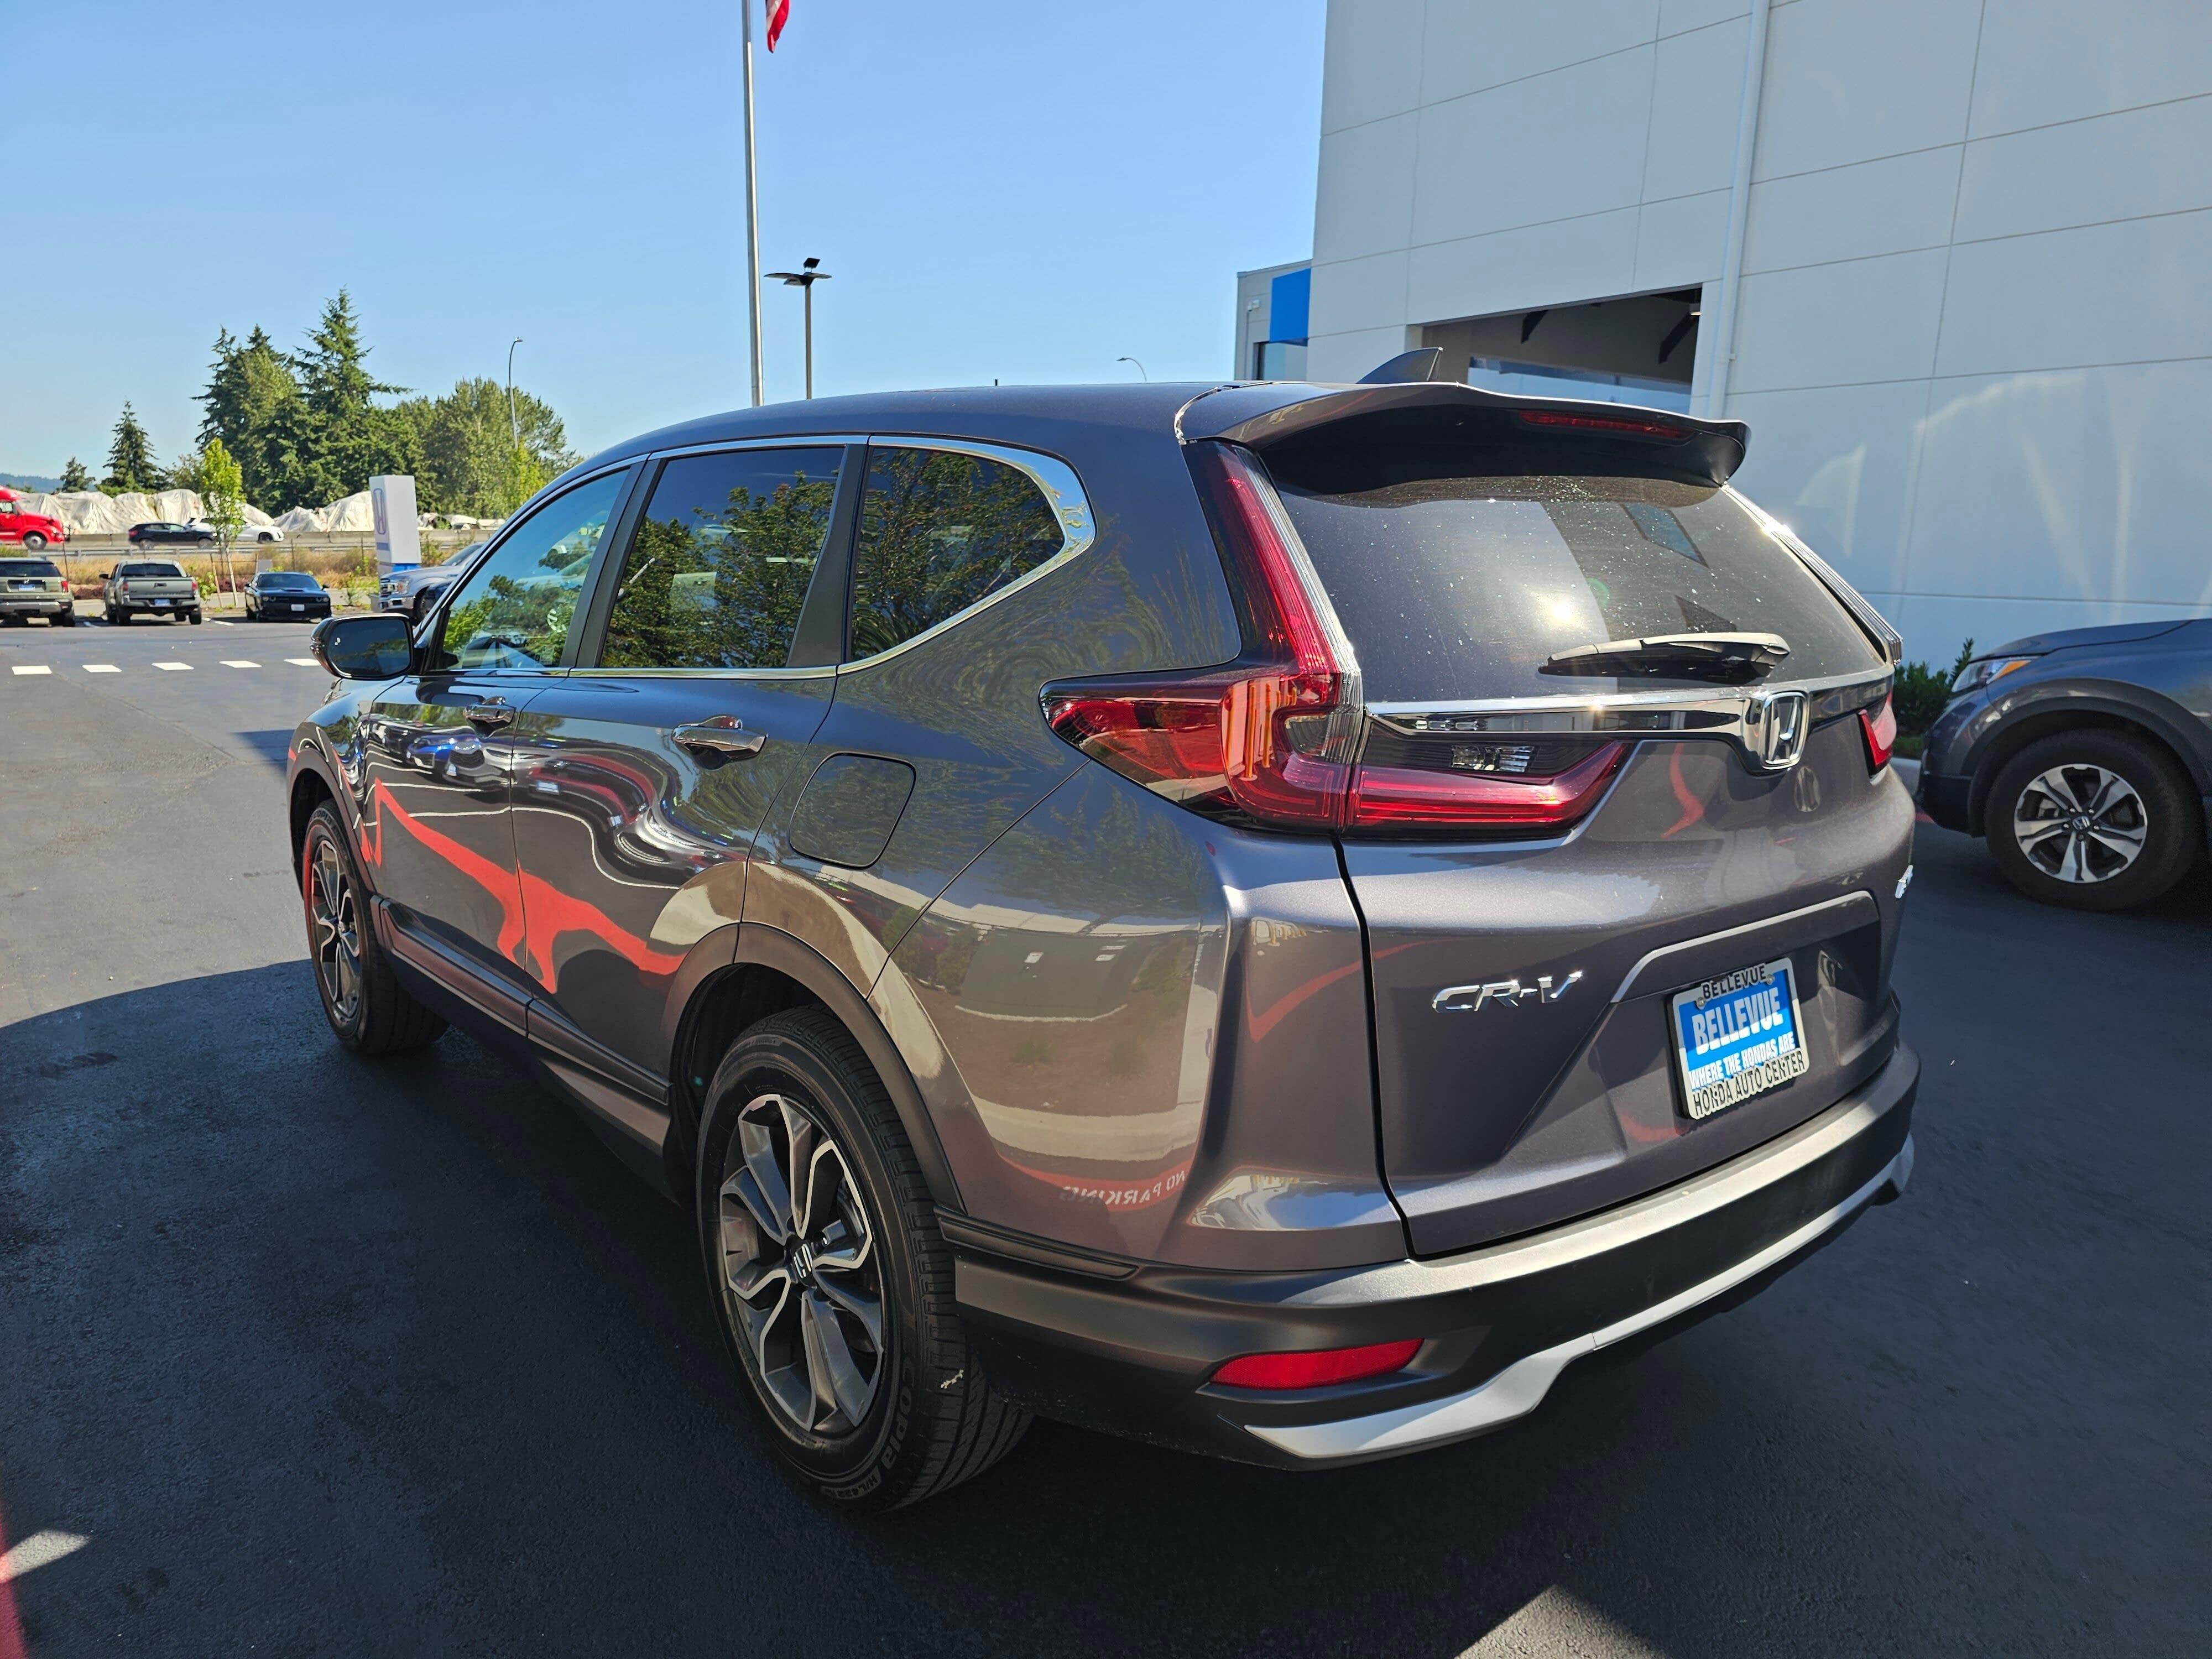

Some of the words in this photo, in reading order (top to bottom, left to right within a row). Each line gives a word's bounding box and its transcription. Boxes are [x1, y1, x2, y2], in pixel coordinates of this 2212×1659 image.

[1432, 971, 1583, 1013] CR-V
[1702, 966, 1766, 999] BELLEVUE
[1692, 988, 1783, 1055] BELLEVUE
[1689, 1061, 1723, 1088] WHERE
[1724, 1054, 1741, 1075] THE
[1743, 1040, 1777, 1067] HONDAS
[1779, 1032, 1796, 1053] ARE
[1693, 1084, 1733, 1116] HONDA
[1736, 1070, 1762, 1098] AUTO
[1765, 1052, 1805, 1083] CENTER
